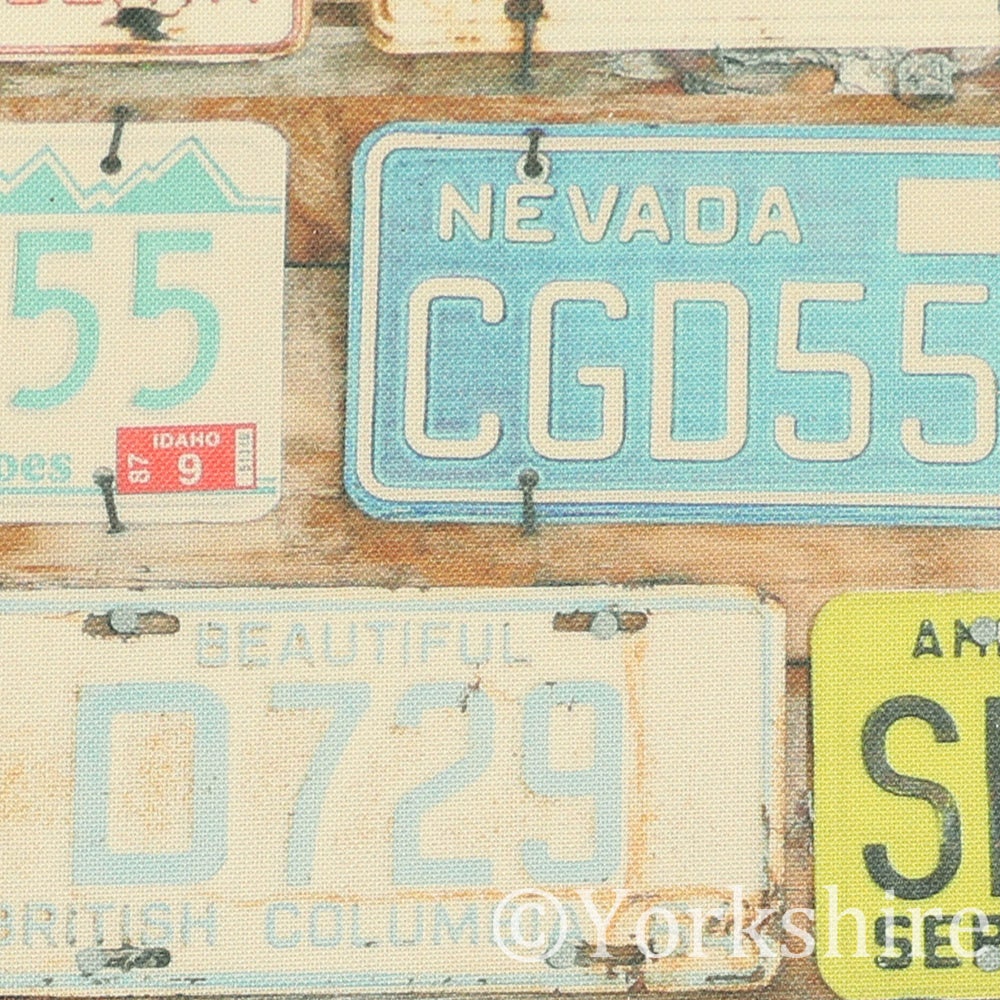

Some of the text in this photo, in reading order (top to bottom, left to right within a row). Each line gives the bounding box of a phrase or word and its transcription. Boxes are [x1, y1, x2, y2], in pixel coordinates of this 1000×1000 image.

[439, 182, 801, 246] NEVADA
[10, 229, 222, 410] 55
[152, 431, 222, 450] IDAHO
[127, 453, 151, 485] 87
[176, 452, 203, 486] 9
[197, 620, 533, 669] BEAUTIFUL
